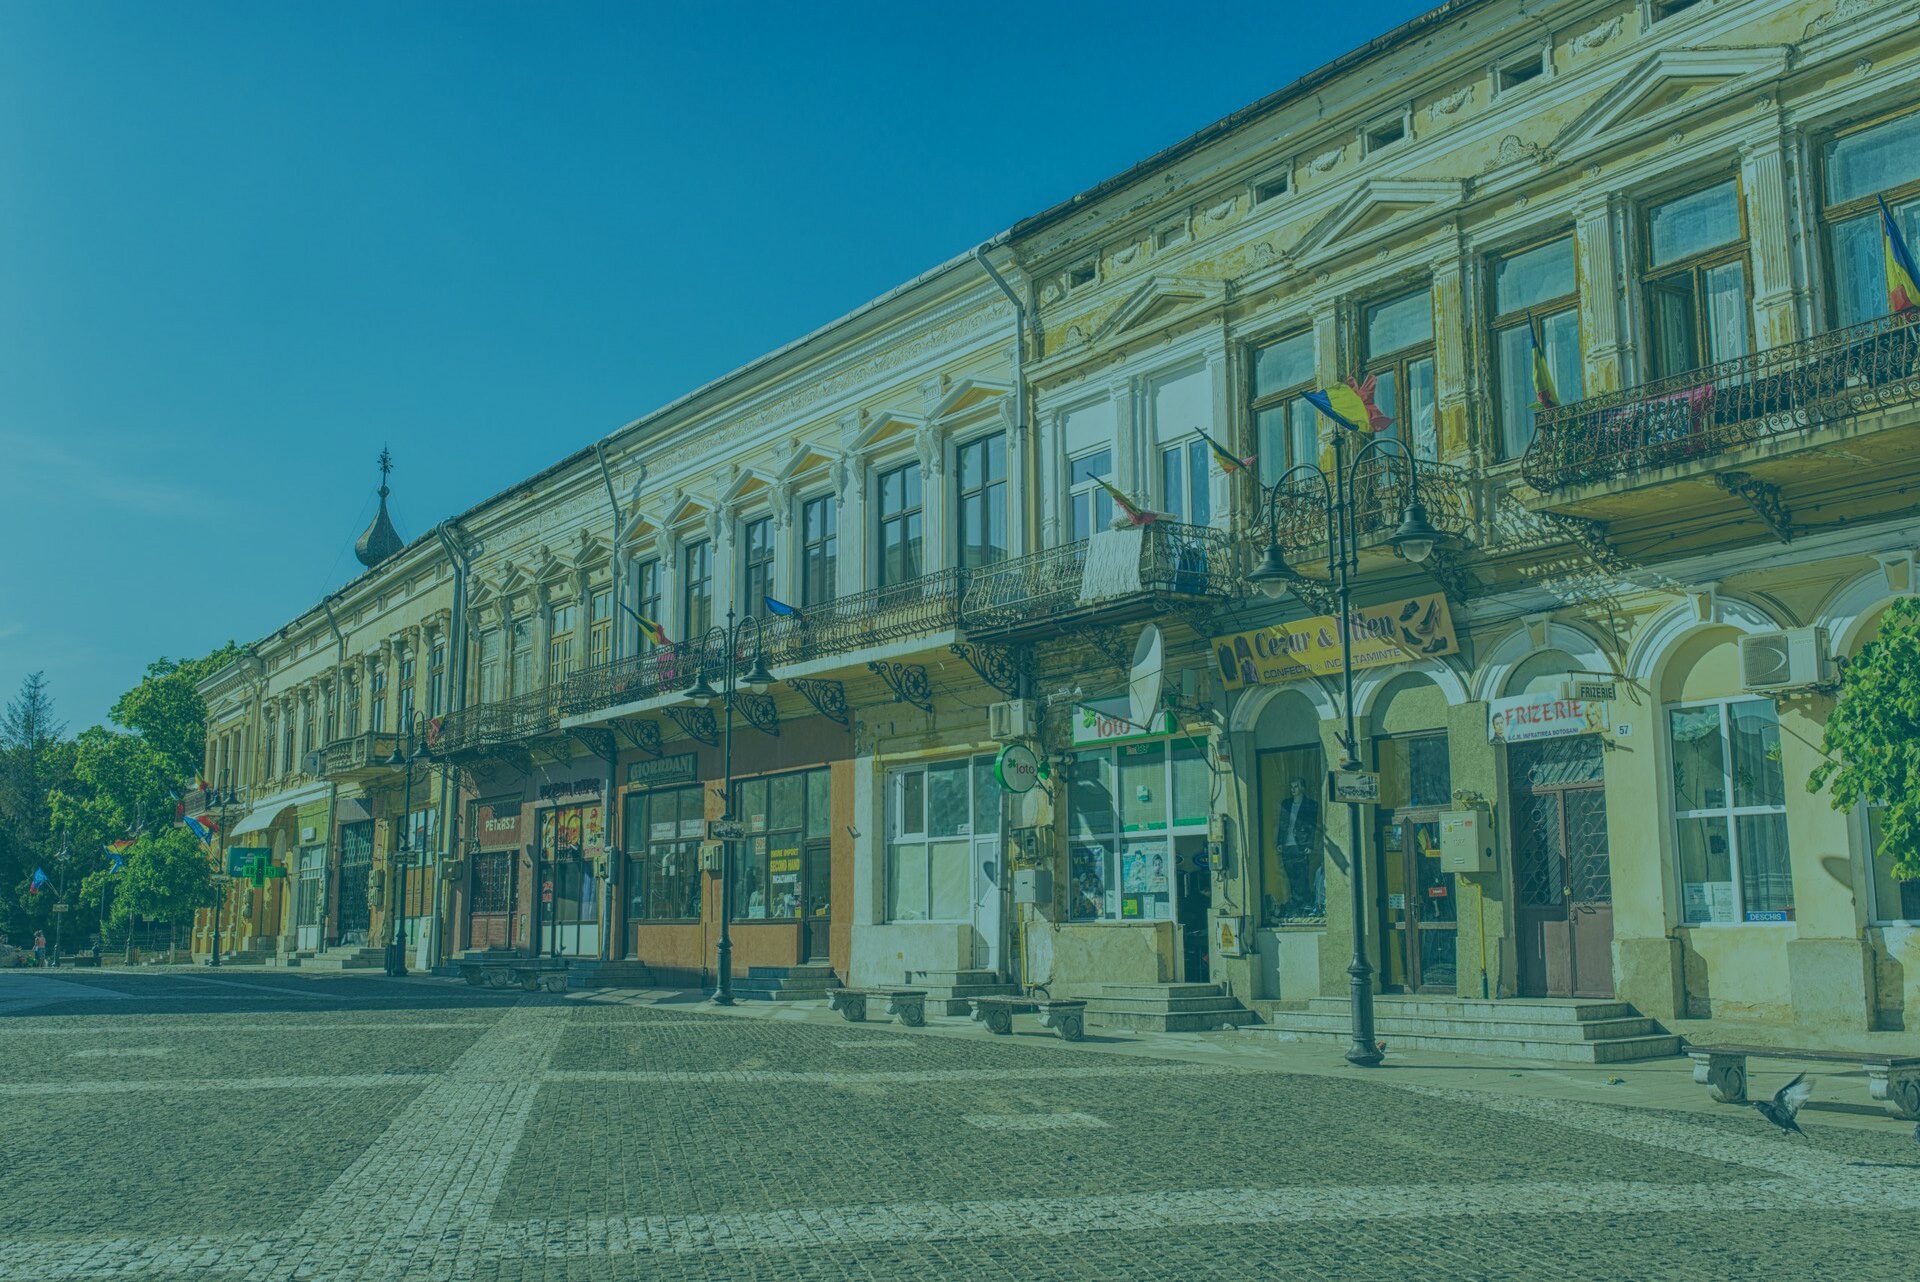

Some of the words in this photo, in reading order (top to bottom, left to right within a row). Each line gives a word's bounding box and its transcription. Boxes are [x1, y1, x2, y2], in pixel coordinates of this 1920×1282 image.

[1256, 632, 1310, 658] Cezar
[1317, 627, 1334, 648] &
[1580, 686, 1613, 699] FRIZERIE
[1505, 700, 1582, 726] FRIZERIE
[1096, 716, 1131, 738] loto
[1552, 728, 1579, 737] BOTOSANI
[1619, 725, 1629, 735] 57
[1016, 763, 1036, 775] loto
[770, 860, 787, 872] SECOND
[788, 858, 800, 871] HAND
[1750, 913, 1782, 921] DESCHIS
